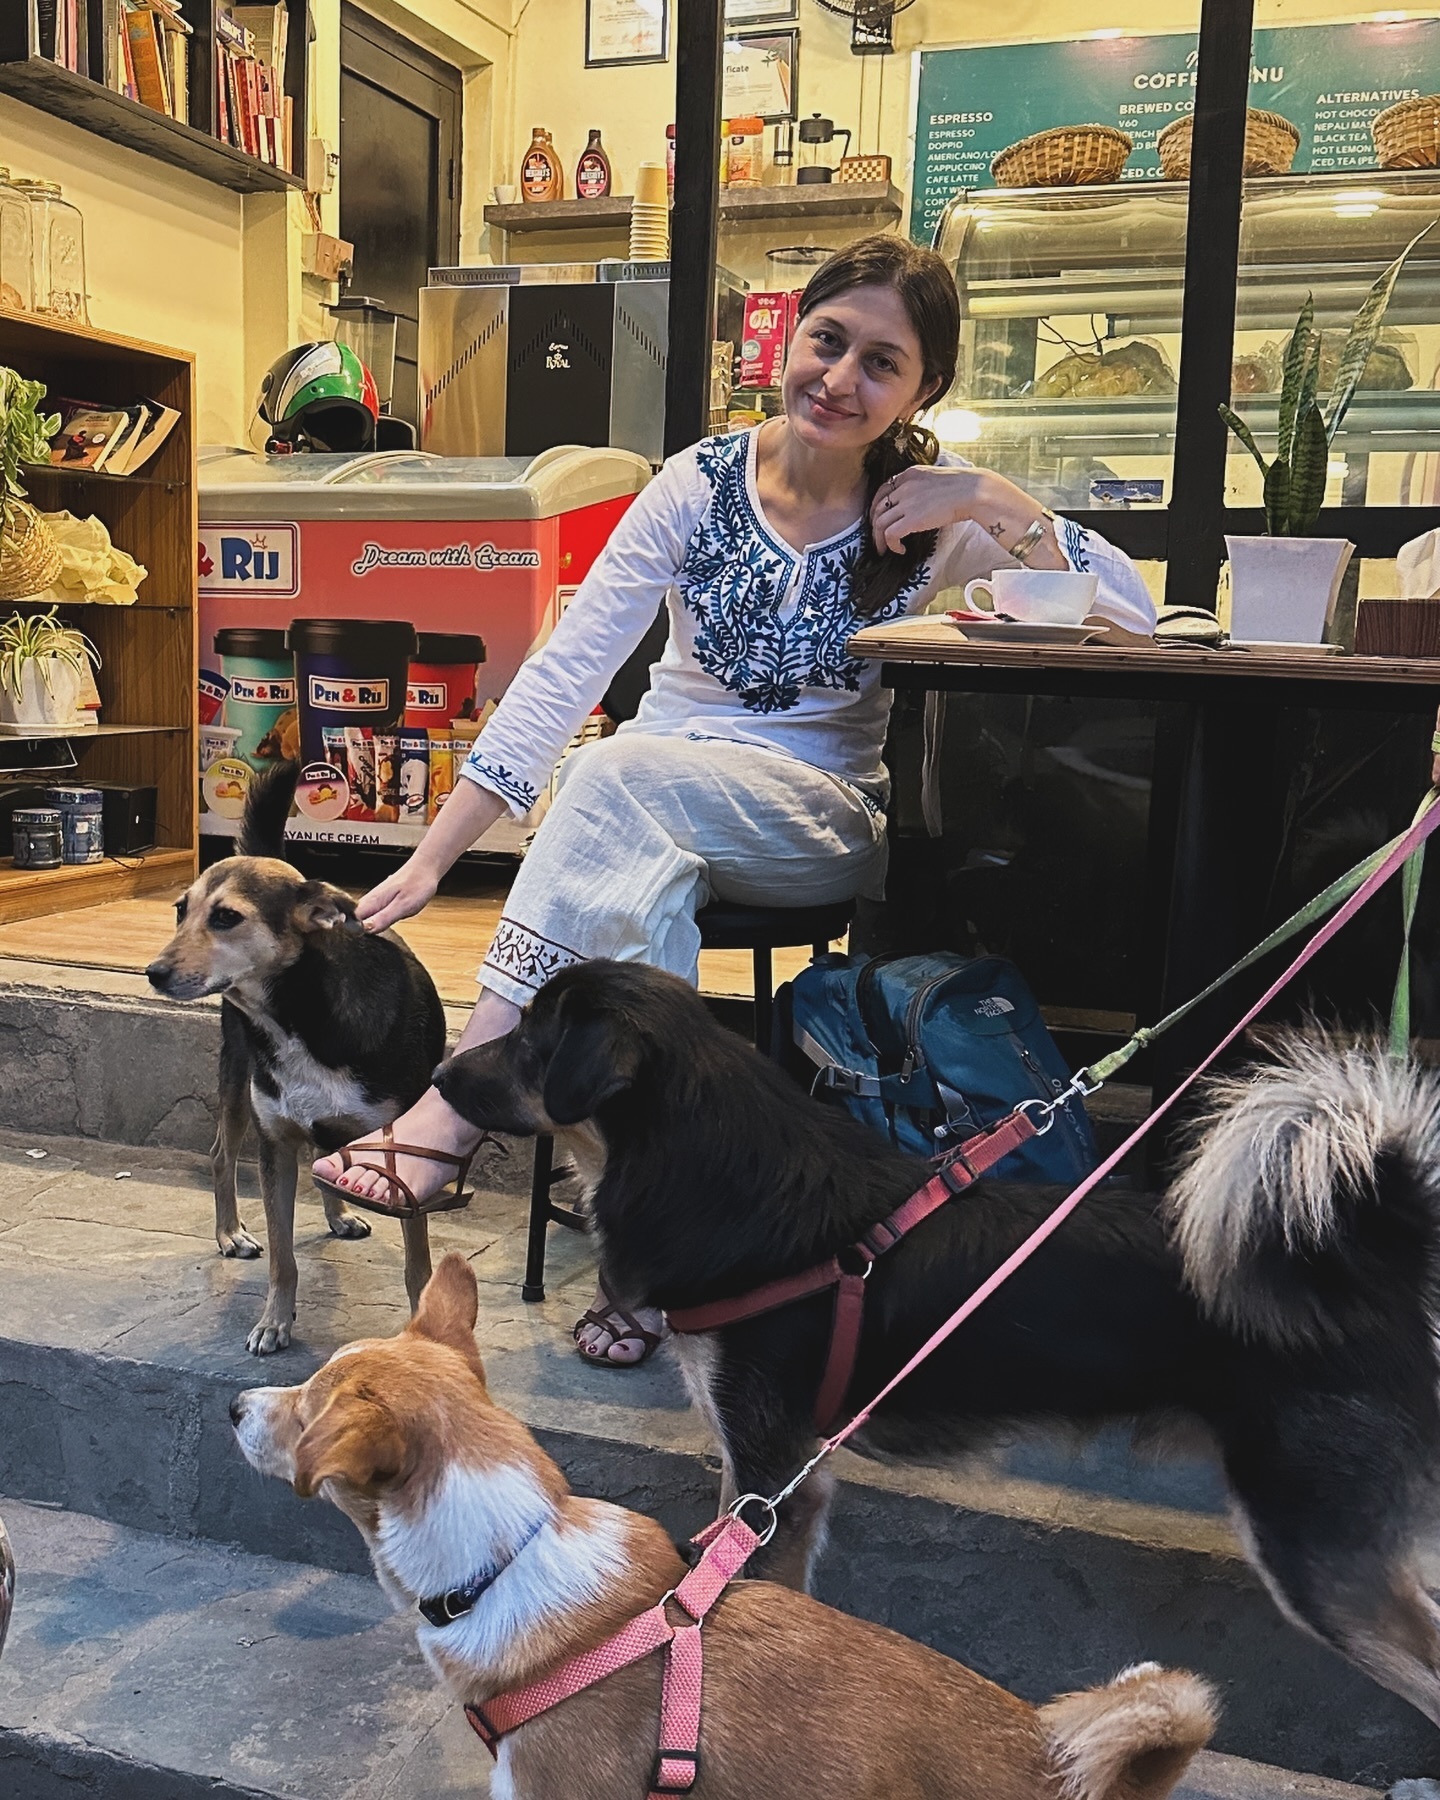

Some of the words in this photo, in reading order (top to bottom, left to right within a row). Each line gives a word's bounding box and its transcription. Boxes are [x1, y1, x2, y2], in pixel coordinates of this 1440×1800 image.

[725, 65, 750, 74] ficate
[1134, 72, 1198, 89] COFFE
[1248, 66, 1284, 83] NU
[1316, 89, 1420, 104] ALTERNATIVES
[1119, 102, 1173, 115] BREWED
[1174, 101, 1195, 112] CO
[930, 112, 993, 125] ESPRESSO
[1315, 111, 1337, 119] HOT
[1118, 119, 1139, 128] V60
[1314, 122, 1349, 131] NEPALI
[1351, 121, 1372, 130] MAS
[929, 129, 975, 139] ESPRESSO
[1314, 134, 1346, 143] BLACK
[1348, 132, 1368, 141] TEA
[928, 141, 963, 150] DOPPIO
[1312, 146, 1335, 154] HOT
[1336, 144, 1371, 153] LEMON
[928, 150, 999, 161] AMERICANO/LO
[1311, 157, 1335, 166] ICED
[1336, 156, 1357, 165] TEA
[1357, 156, 1378, 165] (PEA
[927, 163, 986, 173] CAPPUCCINO
[1120, 167, 1145, 178] CED
[926, 175, 950, 184] CAFE
[951, 173, 979, 182] LATTE
[925, 186, 948, 195] FLAT
[925, 198, 950, 206] CORT
[749, 309, 782, 330] OAT
[354, 544, 426, 575] Dream
[430, 549, 470, 567] with
[475, 544, 540, 568] Cream
[256, 686, 268, 699] &
[342, 688, 356, 703] &
[283, 831, 312, 840] AYAN
[316, 832, 334, 841] ICE
[337, 833, 380, 844] CREAM
